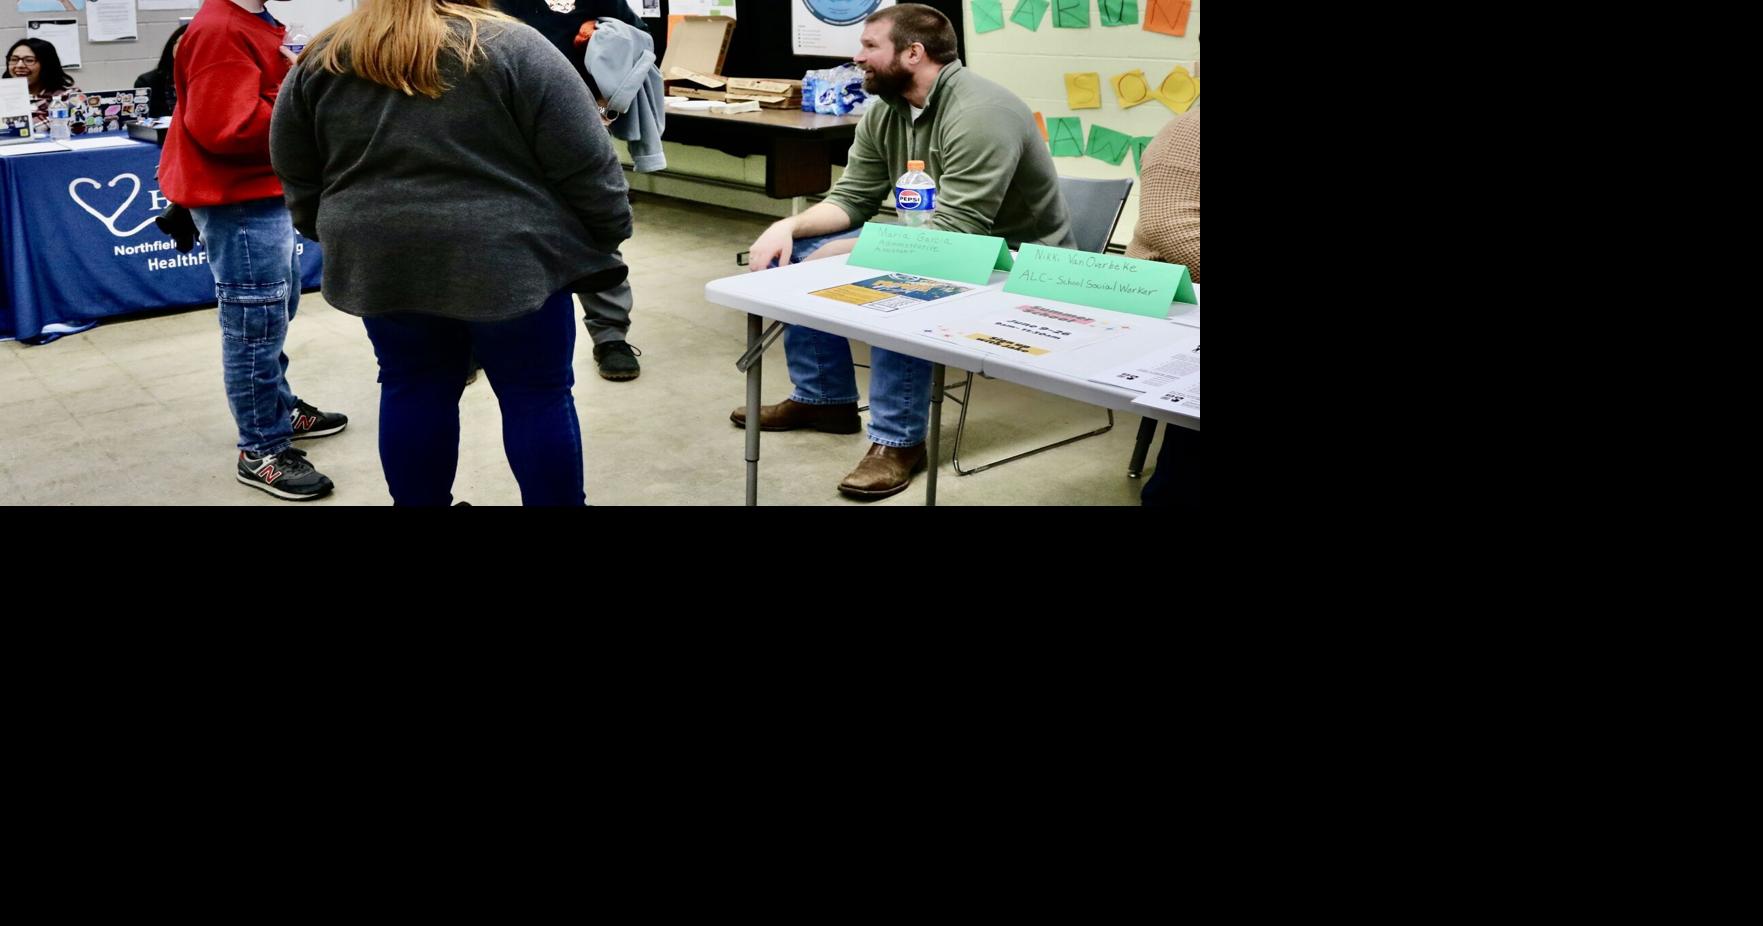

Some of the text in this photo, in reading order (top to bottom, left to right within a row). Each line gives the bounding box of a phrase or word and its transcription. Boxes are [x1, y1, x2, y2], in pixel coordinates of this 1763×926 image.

[880, 227, 952, 245] Maria Garcia
[1056, 276, 1083, 288] School
[1086, 280, 1116, 292] Social
[1007, 319, 1038, 328] June
[294, 415, 317, 430] N
[258, 464, 282, 485] N
